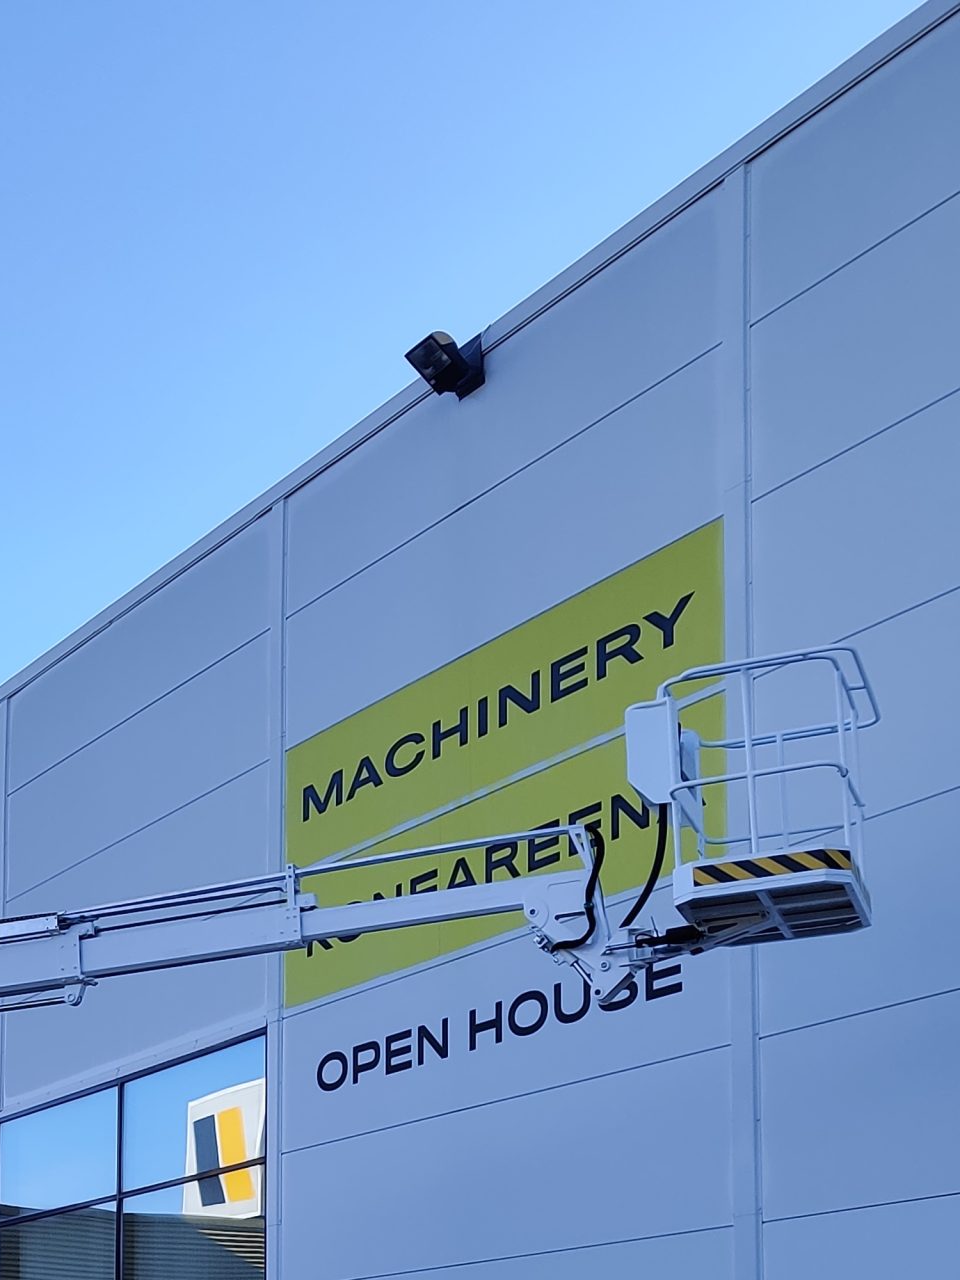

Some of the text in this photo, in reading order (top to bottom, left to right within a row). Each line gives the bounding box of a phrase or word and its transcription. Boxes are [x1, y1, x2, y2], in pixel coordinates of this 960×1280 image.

[301, 590, 696, 822] MACHINERY
[306, 776, 707, 958] EAREEN
[316, 1016, 450, 1092] OPEN
